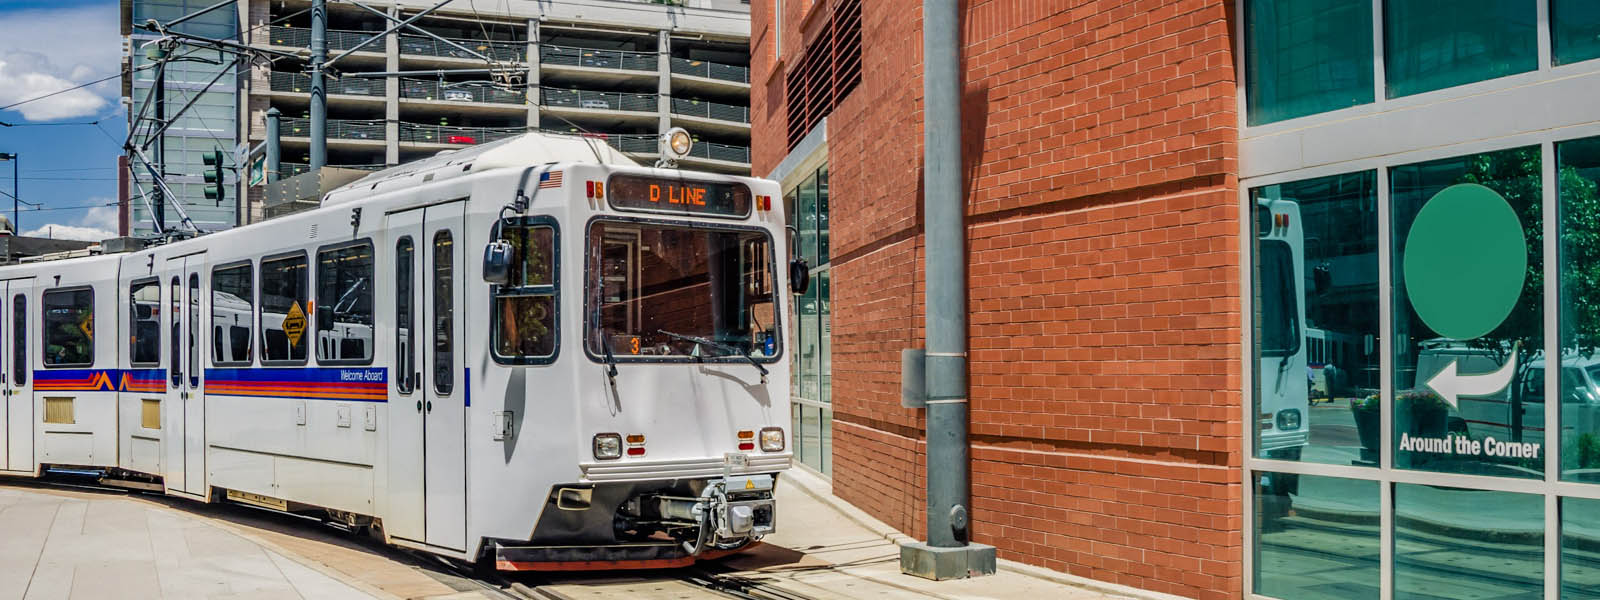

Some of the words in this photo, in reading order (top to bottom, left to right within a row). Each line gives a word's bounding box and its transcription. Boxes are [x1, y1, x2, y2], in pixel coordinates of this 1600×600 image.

[649, 184, 660, 203] D
[669, 185, 706, 206] LINE
[631, 337, 639, 355] 3
[340, 369, 364, 381] Welcome
[364, 369, 383, 381] Aboard
[1399, 432, 1453, 454] Around
[1455, 435, 1481, 456] the
[1483, 436, 1541, 459] Corner
